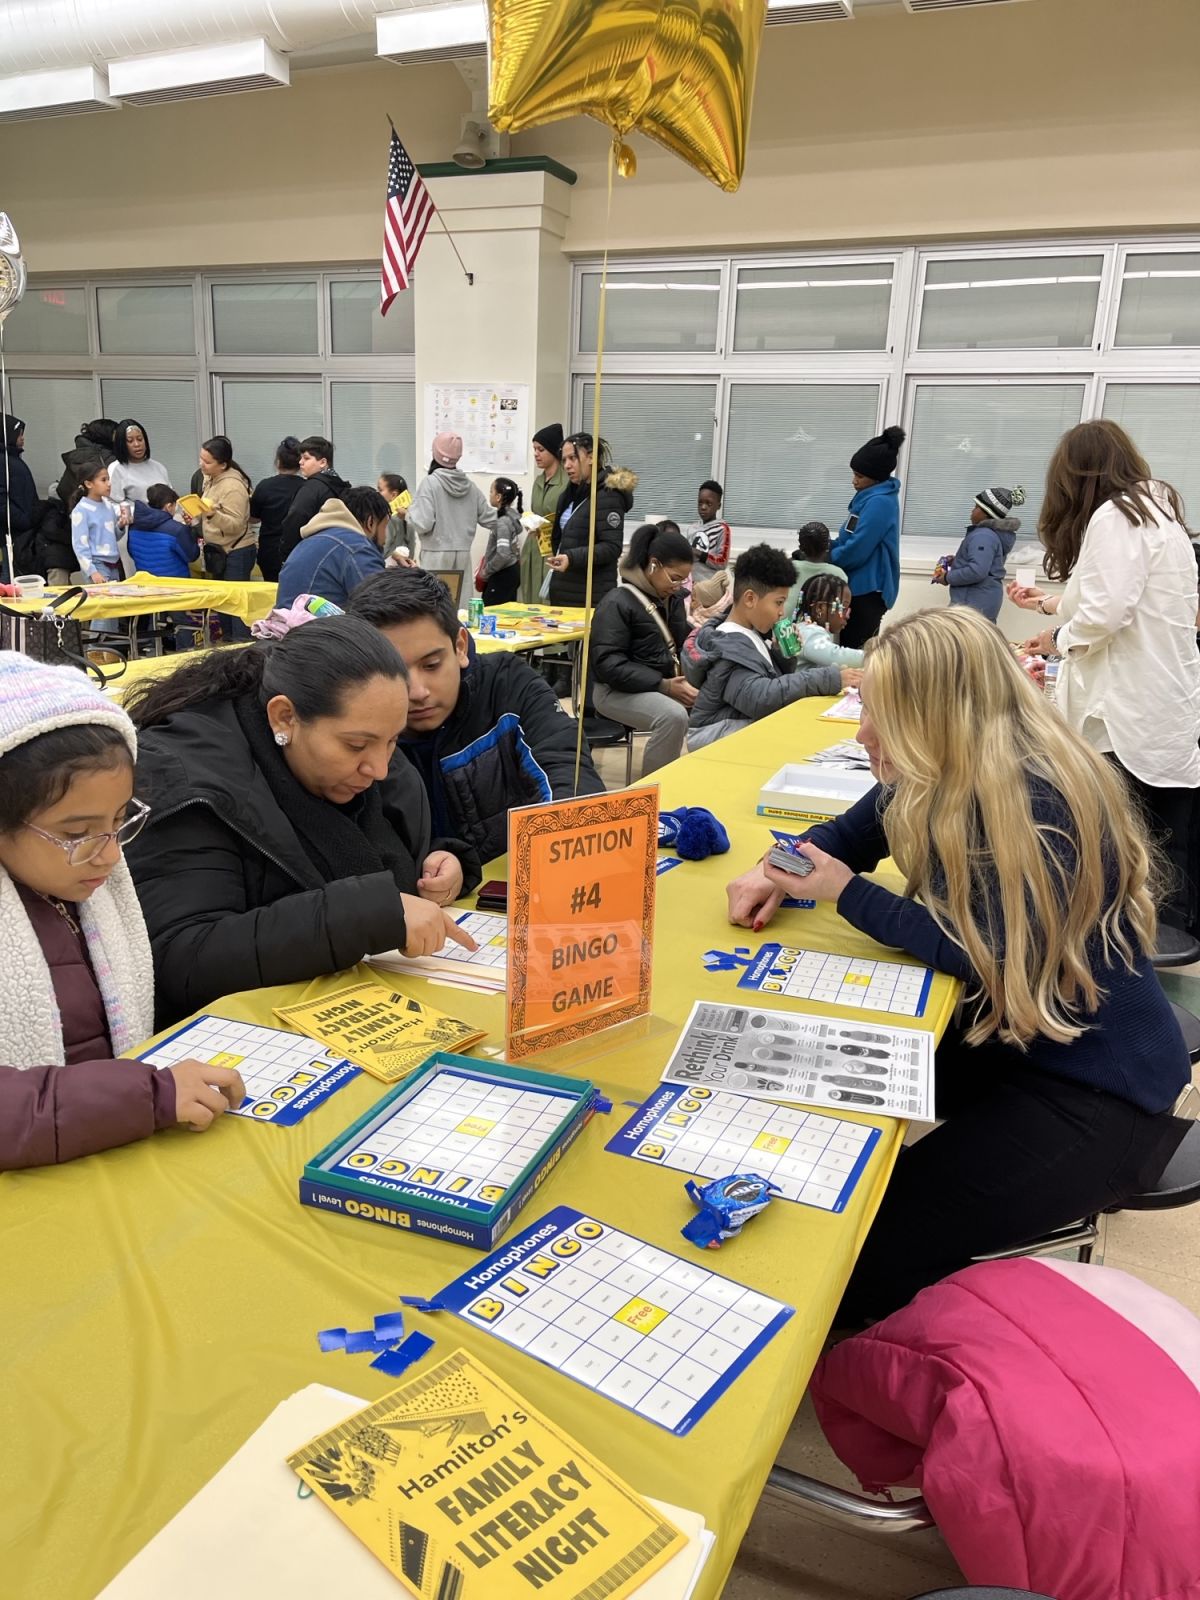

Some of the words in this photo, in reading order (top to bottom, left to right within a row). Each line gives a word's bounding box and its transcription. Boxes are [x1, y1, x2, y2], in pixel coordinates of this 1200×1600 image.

[549, 827, 633, 864] STATION
[570, 882, 602, 915] #4
[552, 933, 618, 970] BINGO
[748, 951, 774, 981] Homophones
[312, 1000, 366, 1022] NIGHT
[552, 976, 614, 1014] GAME
[321, 1002, 394, 1037] LITERACY
[341, 1013, 402, 1043] FAMILY
[351, 1018, 424, 1065] Hamilton's
[675, 1030, 718, 1081] Rethink
[703, 1061, 728, 1083] Your
[717, 1034, 739, 1063] Drink
[293, 1062, 359, 1110] Homophones
[463, 1119, 488, 1134] Free
[624, 1090, 676, 1140] Homophones
[764, 1136, 779, 1151] Free
[310, 1193, 317, 1203] 1
[320, 1195, 342, 1208] Level
[344, 1199, 412, 1229] BINGO
[416, 1218, 475, 1242] Homophones
[463, 1221, 559, 1291] Homophones
[627, 1303, 653, 1327] Free
[396, 1409, 528, 1500] Hamilton's
[435, 1439, 546, 1526] FAMILY
[455, 1460, 593, 1569] LITERACY
[512, 1507, 612, 1590] NIGHT
